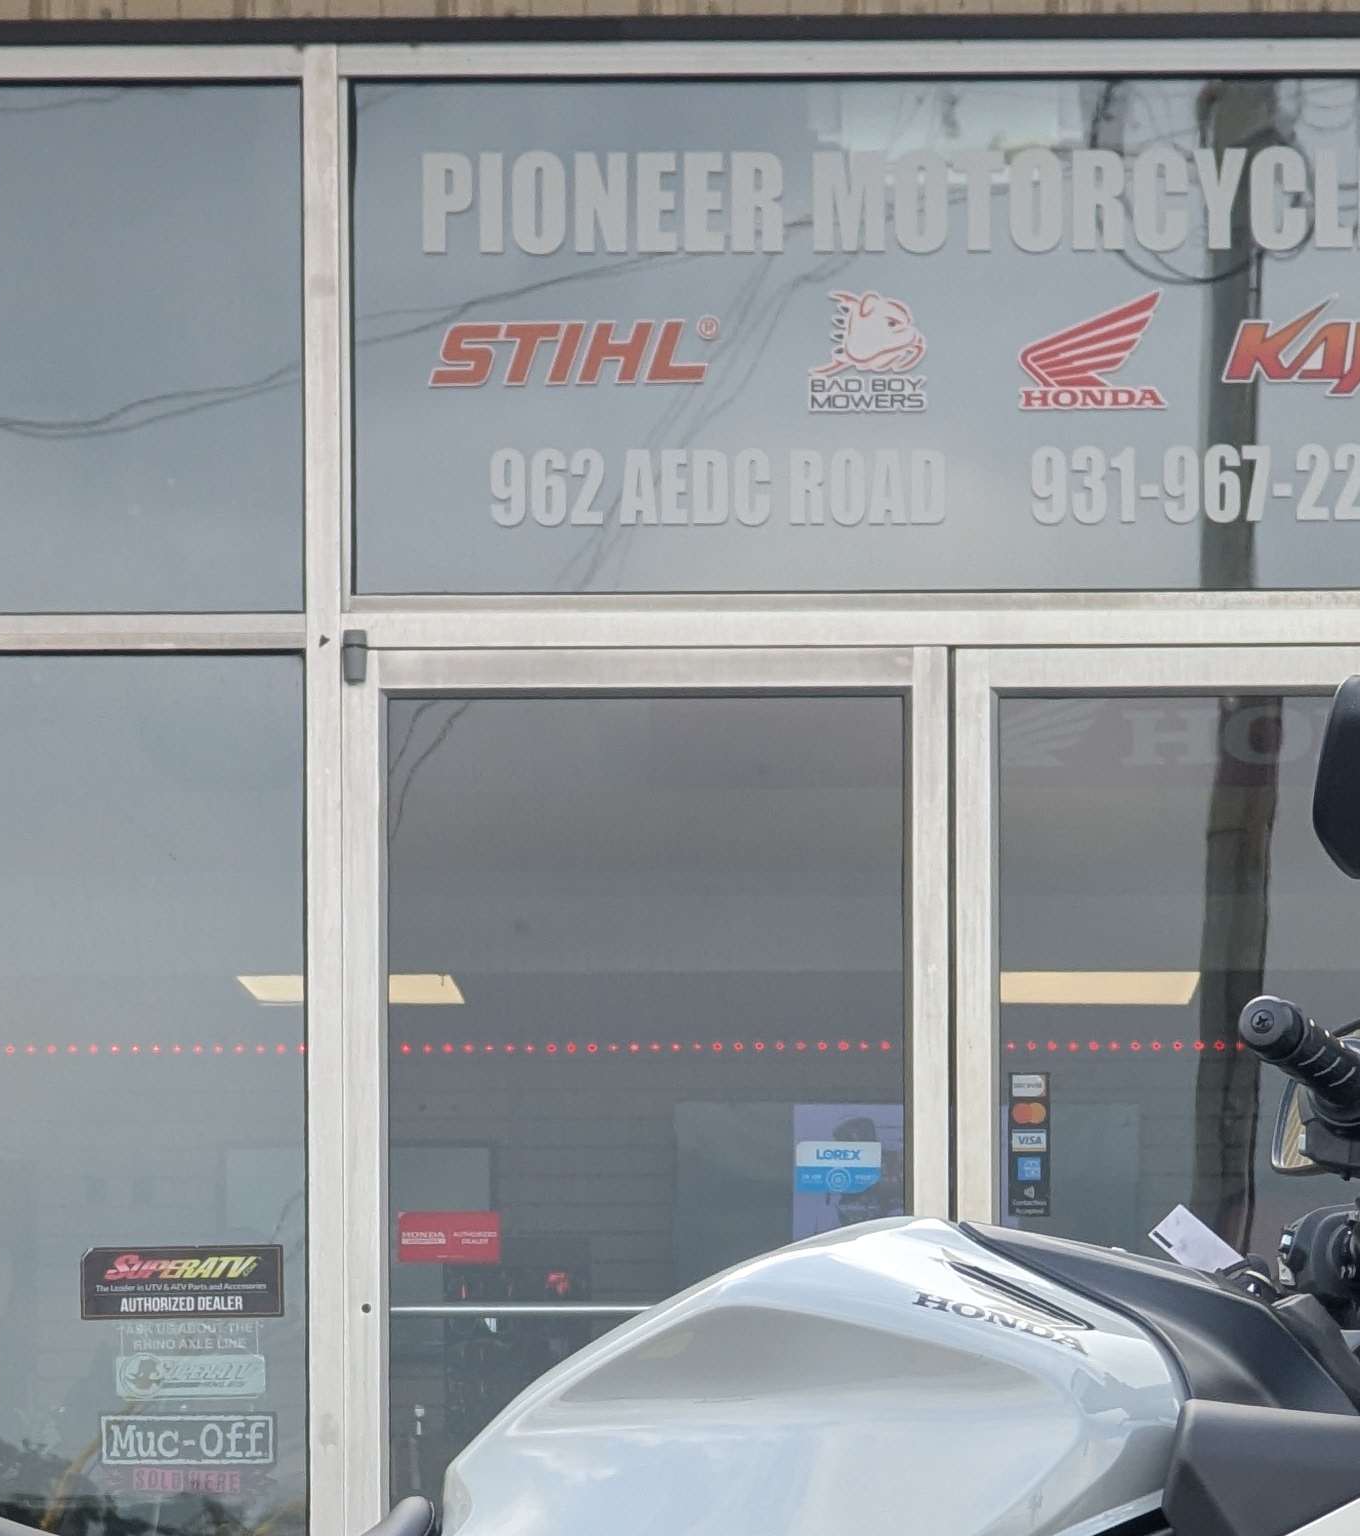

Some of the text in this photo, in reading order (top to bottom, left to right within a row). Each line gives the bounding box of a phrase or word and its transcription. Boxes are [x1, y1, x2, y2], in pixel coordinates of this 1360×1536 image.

[421, 151, 784, 255] PIONEER
[810, 378, 925, 393] BAD BOY
[809, 393, 925, 409] MOWERS
[1020, 387, 1166, 408] HONDA
[489, 446, 948, 527] 962 AEDC ROAD
[1018, 1136, 1043, 1145] VISA
[815, 1149, 861, 1160] LOREX
[96, 1282, 267, 1293] The Leader in UTV & ATV Parts and Accessories
[120, 1296, 243, 1312] AUTHORIZED DEALER
[912, 1291, 1088, 1356] HONDA
[179, 1339, 213, 1350] AXLE
[217, 1338, 247, 1349] LINE
[110, 1421, 266, 1458] Muc-Off
[133, 1469, 240, 1490] SOLD HERE
